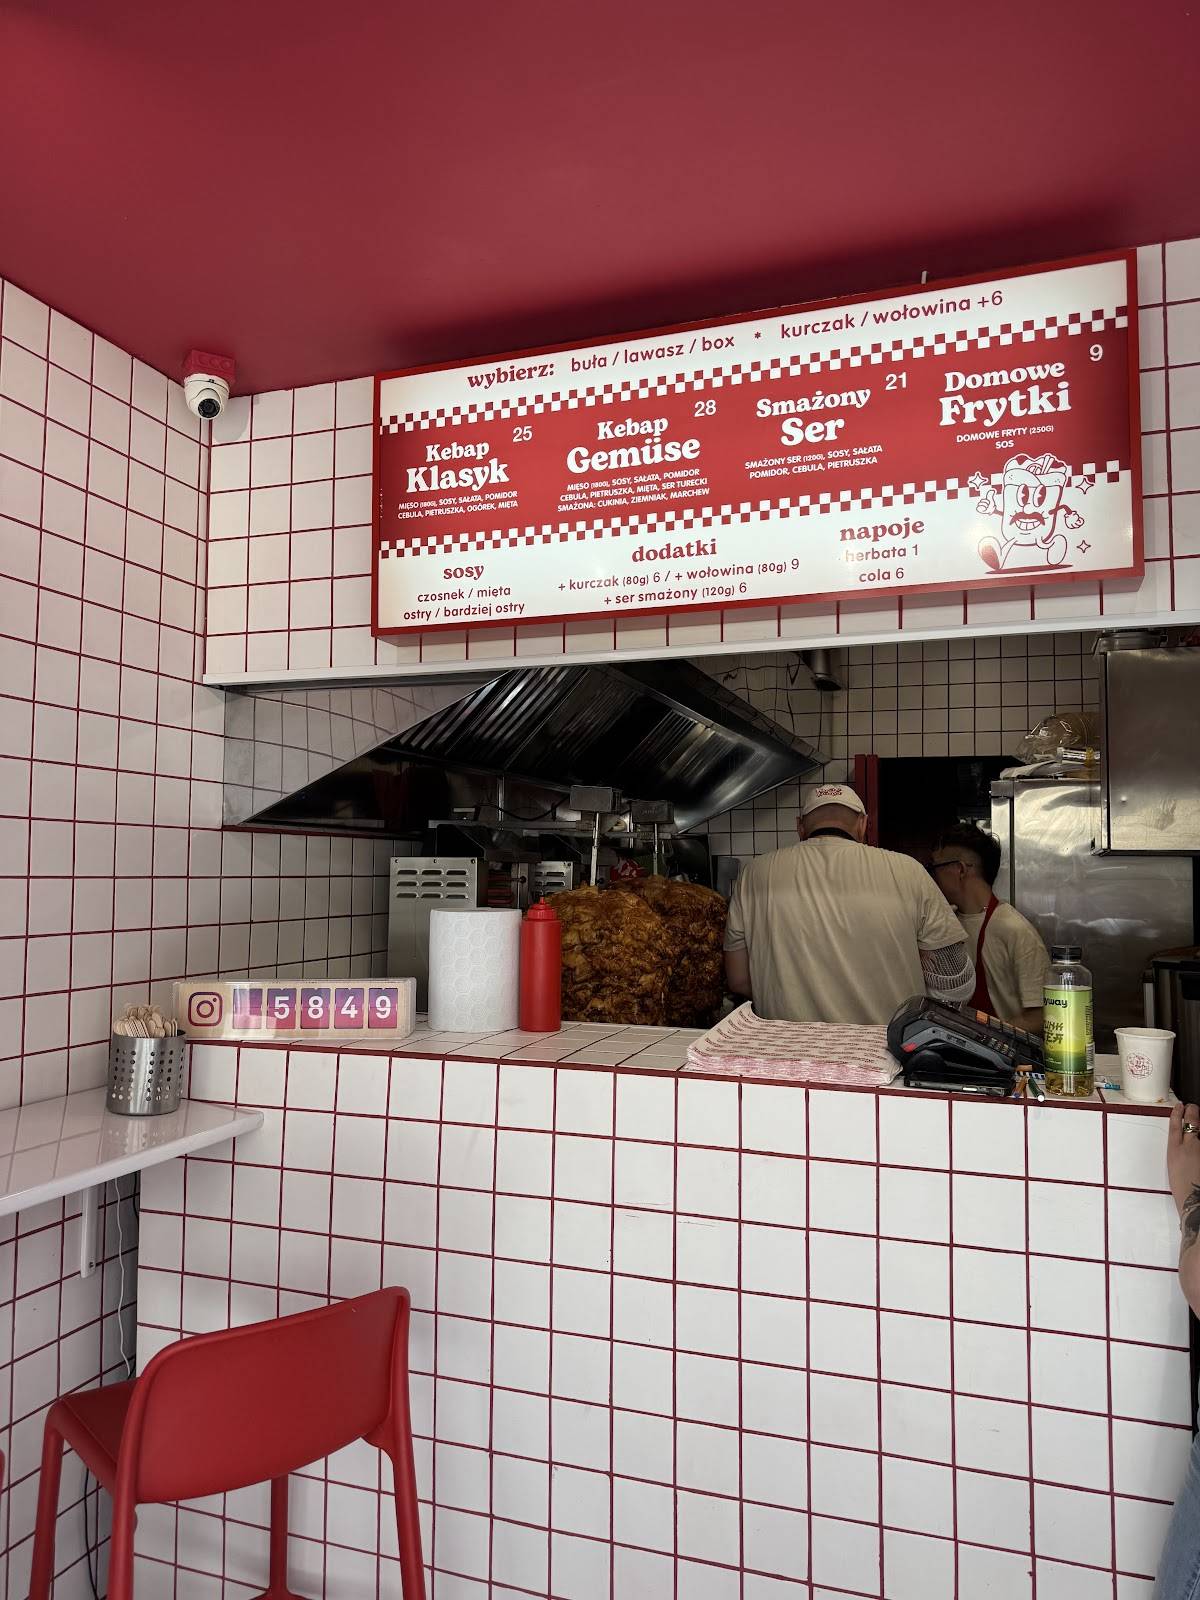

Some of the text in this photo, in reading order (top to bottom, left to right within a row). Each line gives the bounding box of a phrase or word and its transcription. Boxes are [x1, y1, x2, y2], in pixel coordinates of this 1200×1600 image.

[467, 363, 555, 390] wybierz:
[571, 357, 607, 373] buła
[623, 343, 685, 364] lawasz
[701, 336, 735, 352] box
[781, 314, 855, 339] kurczak
[873, 298, 971, 325] wołowina
[977, 290, 1003, 308] +6
[1089, 343, 1104, 362] 9
[885, 371, 907, 391] 21
[944, 362, 1065, 393] Domowe
[694, 399, 717, 417] 28
[756, 388, 871, 418] Smażony
[939, 381, 1072, 427] Frytki
[512, 425, 533, 442] 25
[597, 417, 669, 440] Kebap
[780, 417, 845, 446] Ser
[956, 425, 1054, 443] DOMOWE FRYTY (250G)
[425, 442, 490, 462] Kebap
[566, 437, 701, 474] Gemüse
[995, 440, 1015, 449] SOS
[745, 457, 786, 470] SMAŻONY
[787, 455, 802, 464] SER
[827, 449, 851, 459] SOSY,
[852, 444, 883, 455] SAŁATA
[749, 456, 878, 479] POMIDOR, CEBULA, PIETRUSZKA
[406, 458, 510, 493] Klasyk
[567, 482, 589, 492] MIĘSO
[611, 477, 632, 487] SOSY,
[633, 473, 662, 483] SAŁATA,
[663, 468, 700, 479] POMIDOR
[398, 500, 419, 510] MIĘSO
[485, 490, 518, 501] POMIDOR
[557, 488, 710, 512] SMAŻONA: CUKINIA, ZIEMNIAK, MARCHEW
[560, 493, 588, 502] CEBULA,
[590, 487, 635, 499] PIETRUSZKA,
[662, 482, 677, 490] SER
[677, 478, 708, 488] TURECKI
[424, 506, 466, 517] PIETRUSZKA,
[498, 500, 518, 509] MIĘTA
[840, 517, 925, 542] napoje
[632, 538, 717, 562] dodatki
[845, 544, 918, 562] herbata 1
[443, 565, 484, 580] sosy
[569, 575, 619, 590] kurczak
[622, 574, 649, 587] (80g)
[653, 572, 661, 583] 6
[687, 564, 753, 579] wołowina
[758, 562, 787, 575] (80g)
[791, 558, 799, 570] 9
[859, 567, 904, 582] cola 6
[417, 589, 465, 603] czosnek
[477, 586, 511, 599] mięta
[615, 593, 635, 604] ser
[638, 588, 697, 601] smażony
[702, 585, 735, 598] (120g)
[739, 582, 747, 593] 6
[403, 609, 432, 622] ostry
[444, 603, 492, 617] bardziej
[495, 602, 525, 614] ostry
